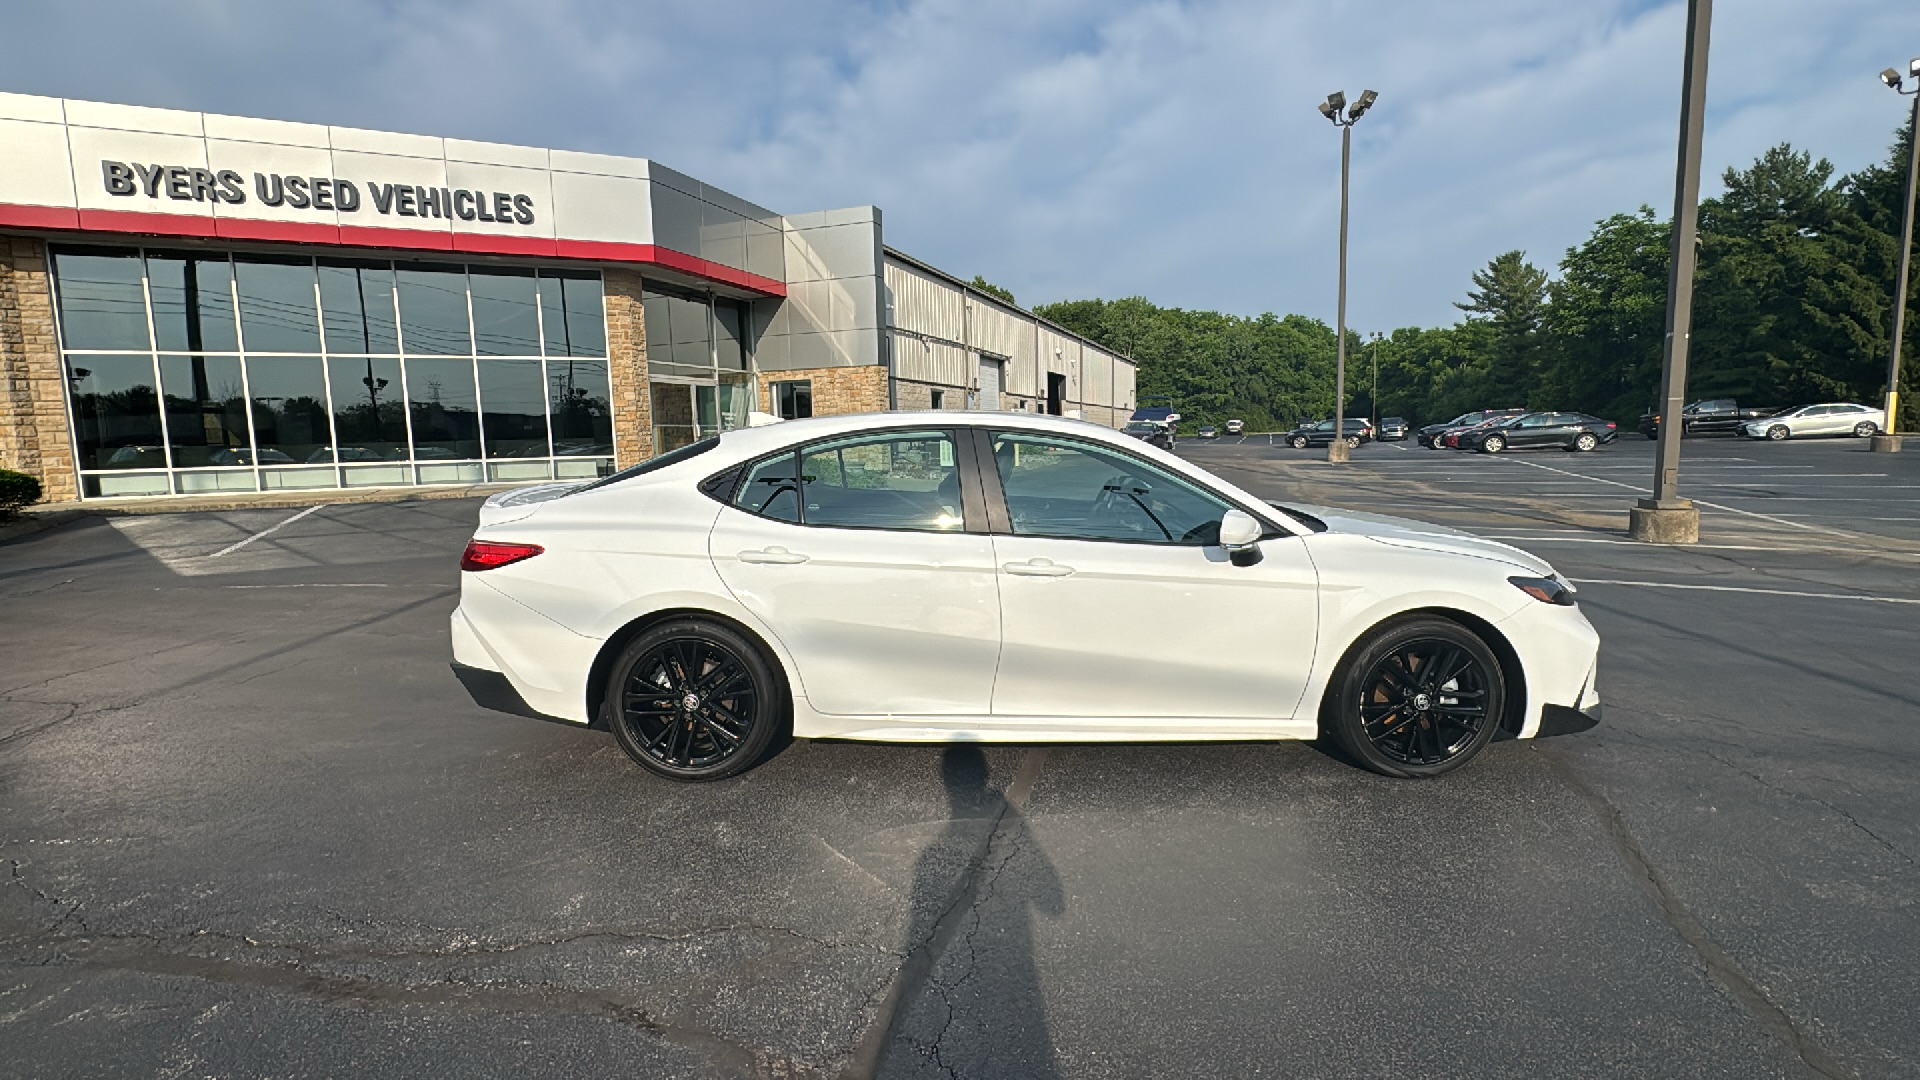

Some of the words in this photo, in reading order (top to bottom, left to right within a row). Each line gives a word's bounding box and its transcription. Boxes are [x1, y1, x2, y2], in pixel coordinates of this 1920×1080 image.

[101, 159, 246, 204] BYERS
[254, 172, 361, 212] USED
[367, 181, 535, 224] VEHICLES
